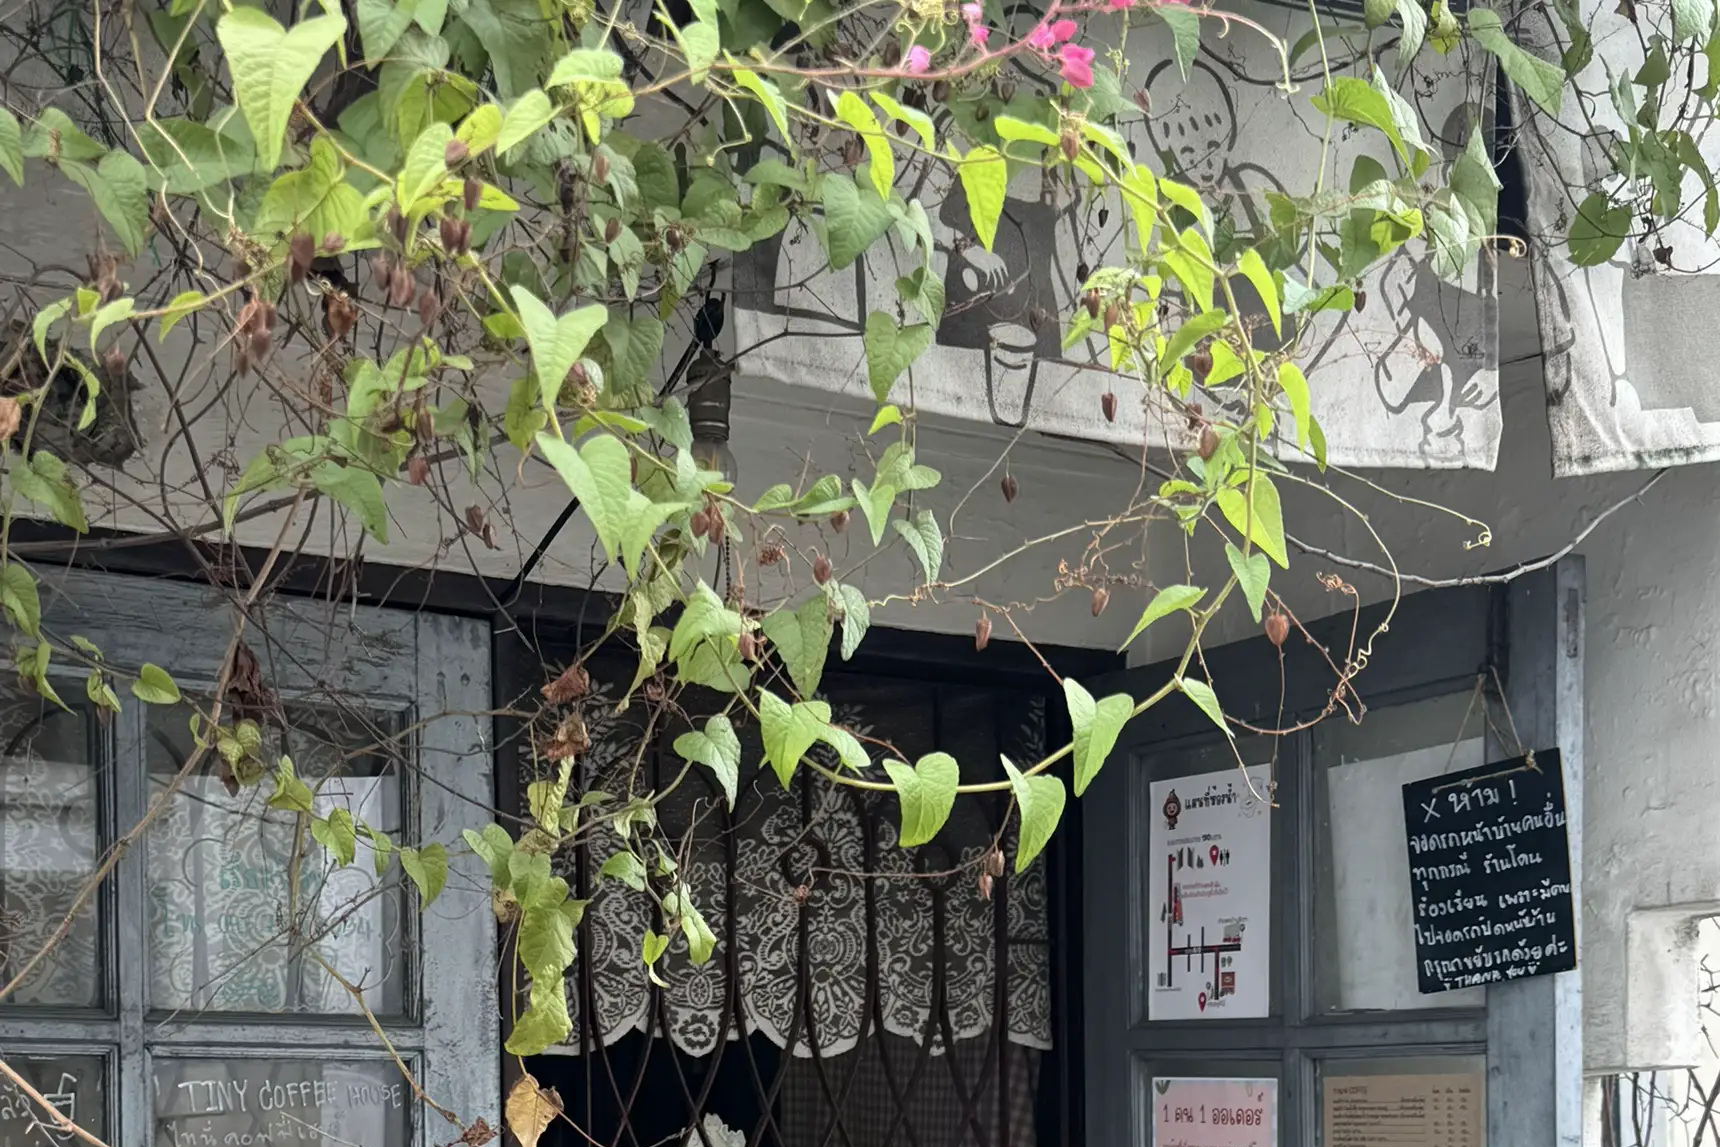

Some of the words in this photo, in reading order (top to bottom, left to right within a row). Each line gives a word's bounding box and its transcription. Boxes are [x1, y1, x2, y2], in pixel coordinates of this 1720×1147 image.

[1450, 783, 1500, 813] ห้าม
[178, 1080, 249, 1112] TINY
[259, 1080, 337, 1111] COFFEE
[1163, 1104, 1169, 1122] 1
[1175, 1107, 1194, 1123] คน
[1199, 1104, 1206, 1123] 1
[1212, 1093, 1264, 1126] ออเดอร์
